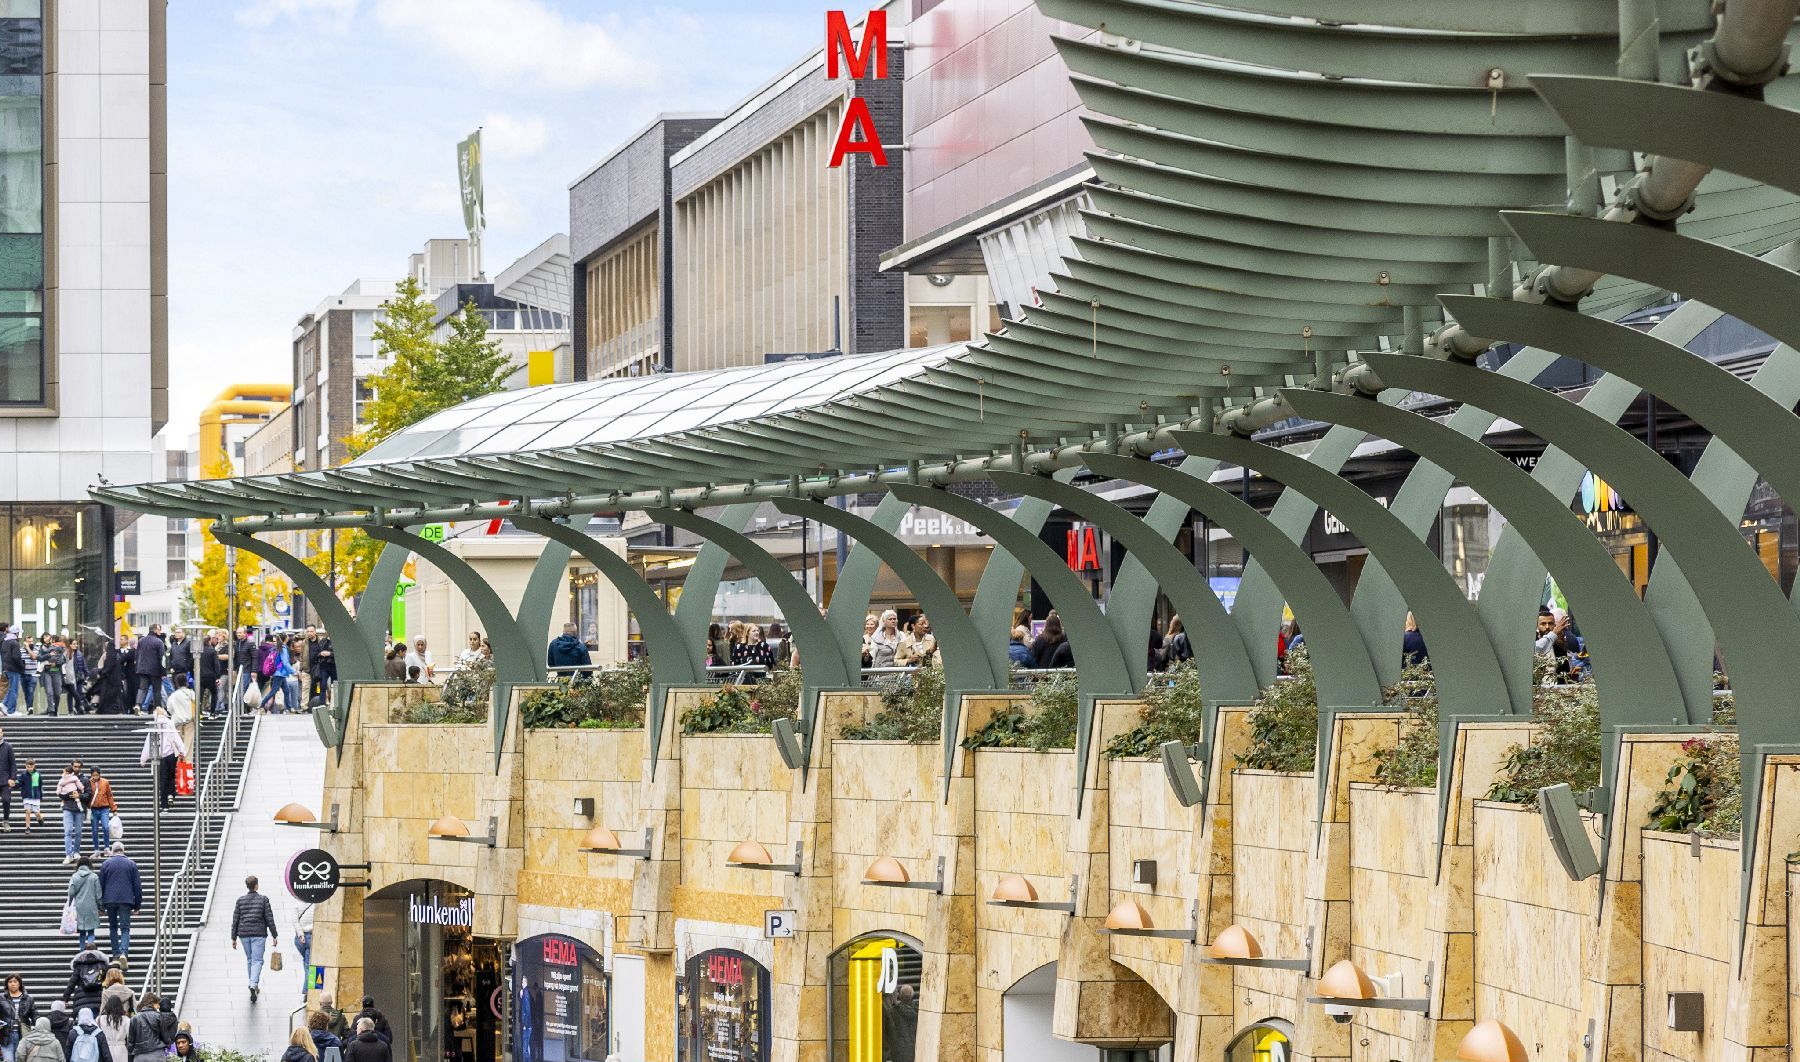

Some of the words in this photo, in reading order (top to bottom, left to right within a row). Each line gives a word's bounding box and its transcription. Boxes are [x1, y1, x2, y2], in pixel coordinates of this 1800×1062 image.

[424, 527, 441, 539] DE
[13, 597, 70, 639] Hi!
[770, 915, 783, 936] P
[543, 938, 578, 967] HEMA
[708, 954, 744, 985] HEMA
[876, 947, 899, 994] JD
